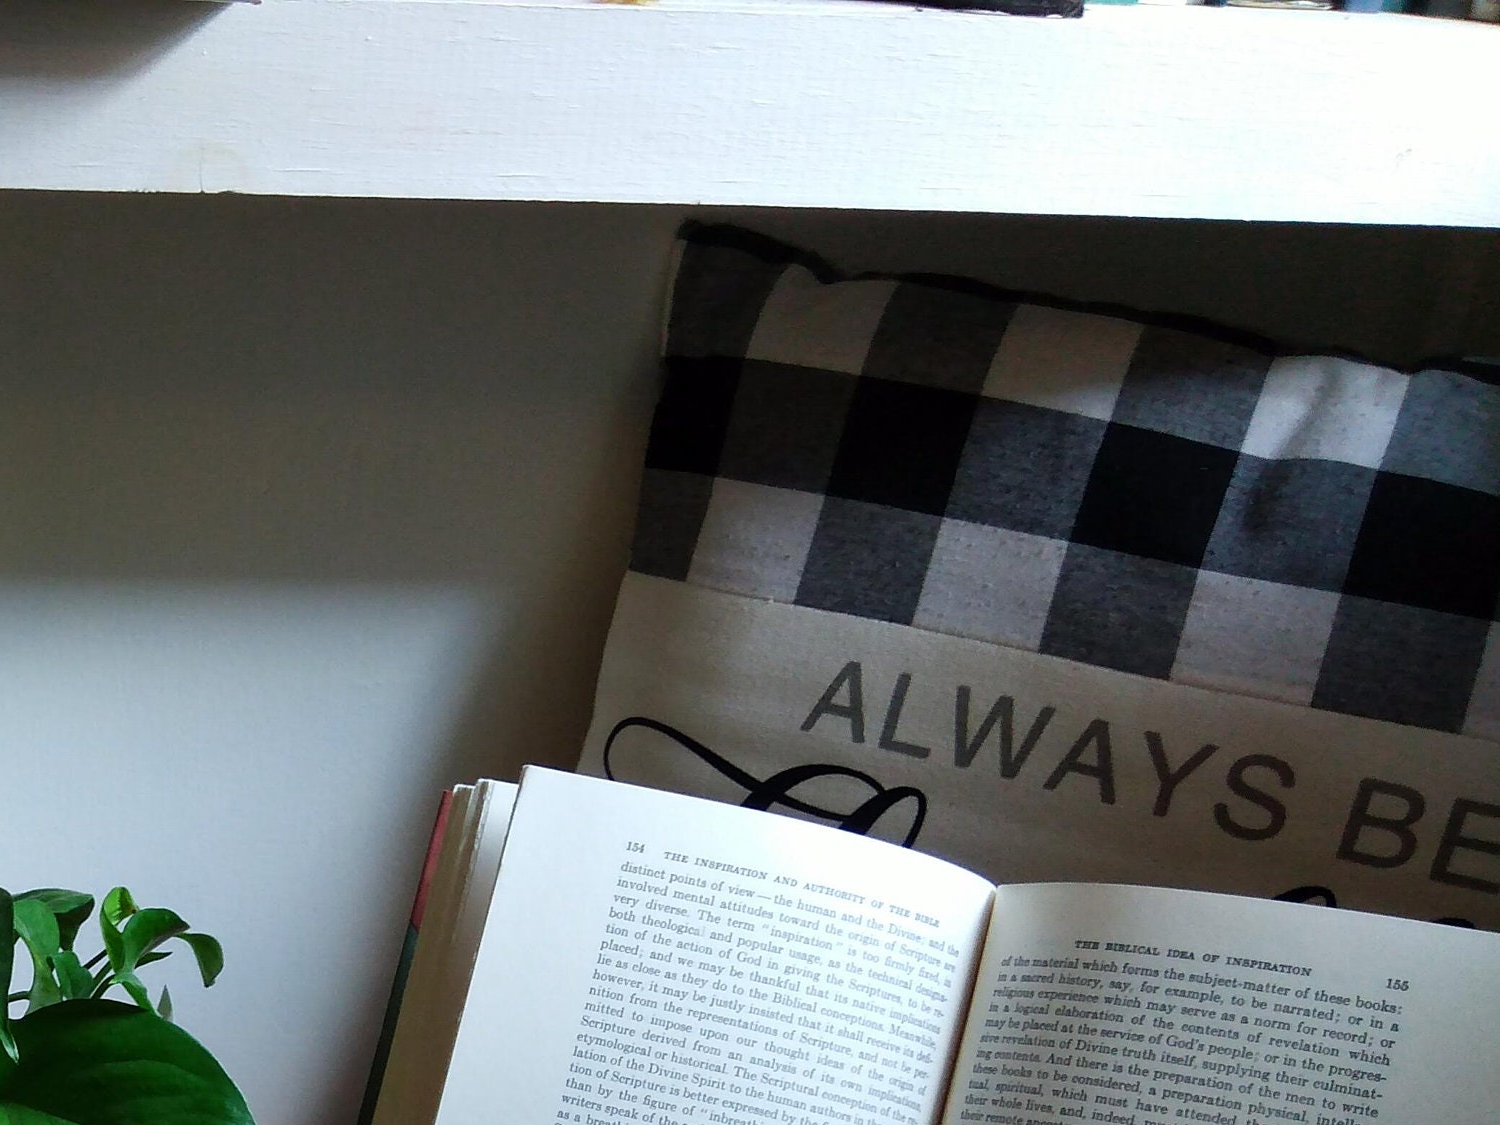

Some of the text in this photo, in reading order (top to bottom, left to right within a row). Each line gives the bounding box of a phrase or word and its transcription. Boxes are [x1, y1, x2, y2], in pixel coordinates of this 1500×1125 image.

[801, 660, 1296, 841] ALWAYS
[1336, 777, 1500, 896] BE
[625, 841, 940, 928] 154 THE INSPIRATION AND AUTHORITY OF THE BIBLE
[616, 876, 941, 967] involved mental attitudes toward the origin of Scripture
[1031, 957, 1079, 969] material
[1082, 959, 1118, 973] which
[1121, 962, 1159, 977] forms
[1163, 967, 1185, 981] the
[1188, 972, 1290, 996] subject-matter
[1294, 987, 1311, 999] of
[1314, 989, 1351, 1006] these
[1355, 995, 1402, 1015] books:
[1074, 940, 1409, 991] THE BIBLICAL IDEA OF INSPIRATION 155
[562, 1094, 602, 1111] writers
[604, 1105, 639, 1119] speak
[641, 1112, 656, 1123] of
[572, 1045, 607, 1063] lation
[609, 1055, 624, 1066] of
[626, 1058, 645, 1072] the
[647, 1062, 689, 1082] Divine
[690, 1072, 726, 1091] Spirit
[729, 1083, 742, 1094] to
[745, 1085, 764, 1099] the
[766, 1090, 807, 1110] human
[809, 1104, 852, 1122] authors
[853, 1113, 864, 1125] in
[1045, 1053, 1073, 1066] And
[1075, 1056, 1108, 1071] there
[1111, 1060, 1123, 1073] is
[1127, 1063, 1150, 1077] the
[1237, 1082, 1255, 1095] of
[1258, 1085, 1281, 1100] the
[1285, 1092, 1315, 1106] men
[1321, 1097, 1336, 1110] to
[1342, 1103, 1378, 1118] write
[985, 1114, 1024, 1125] remote
